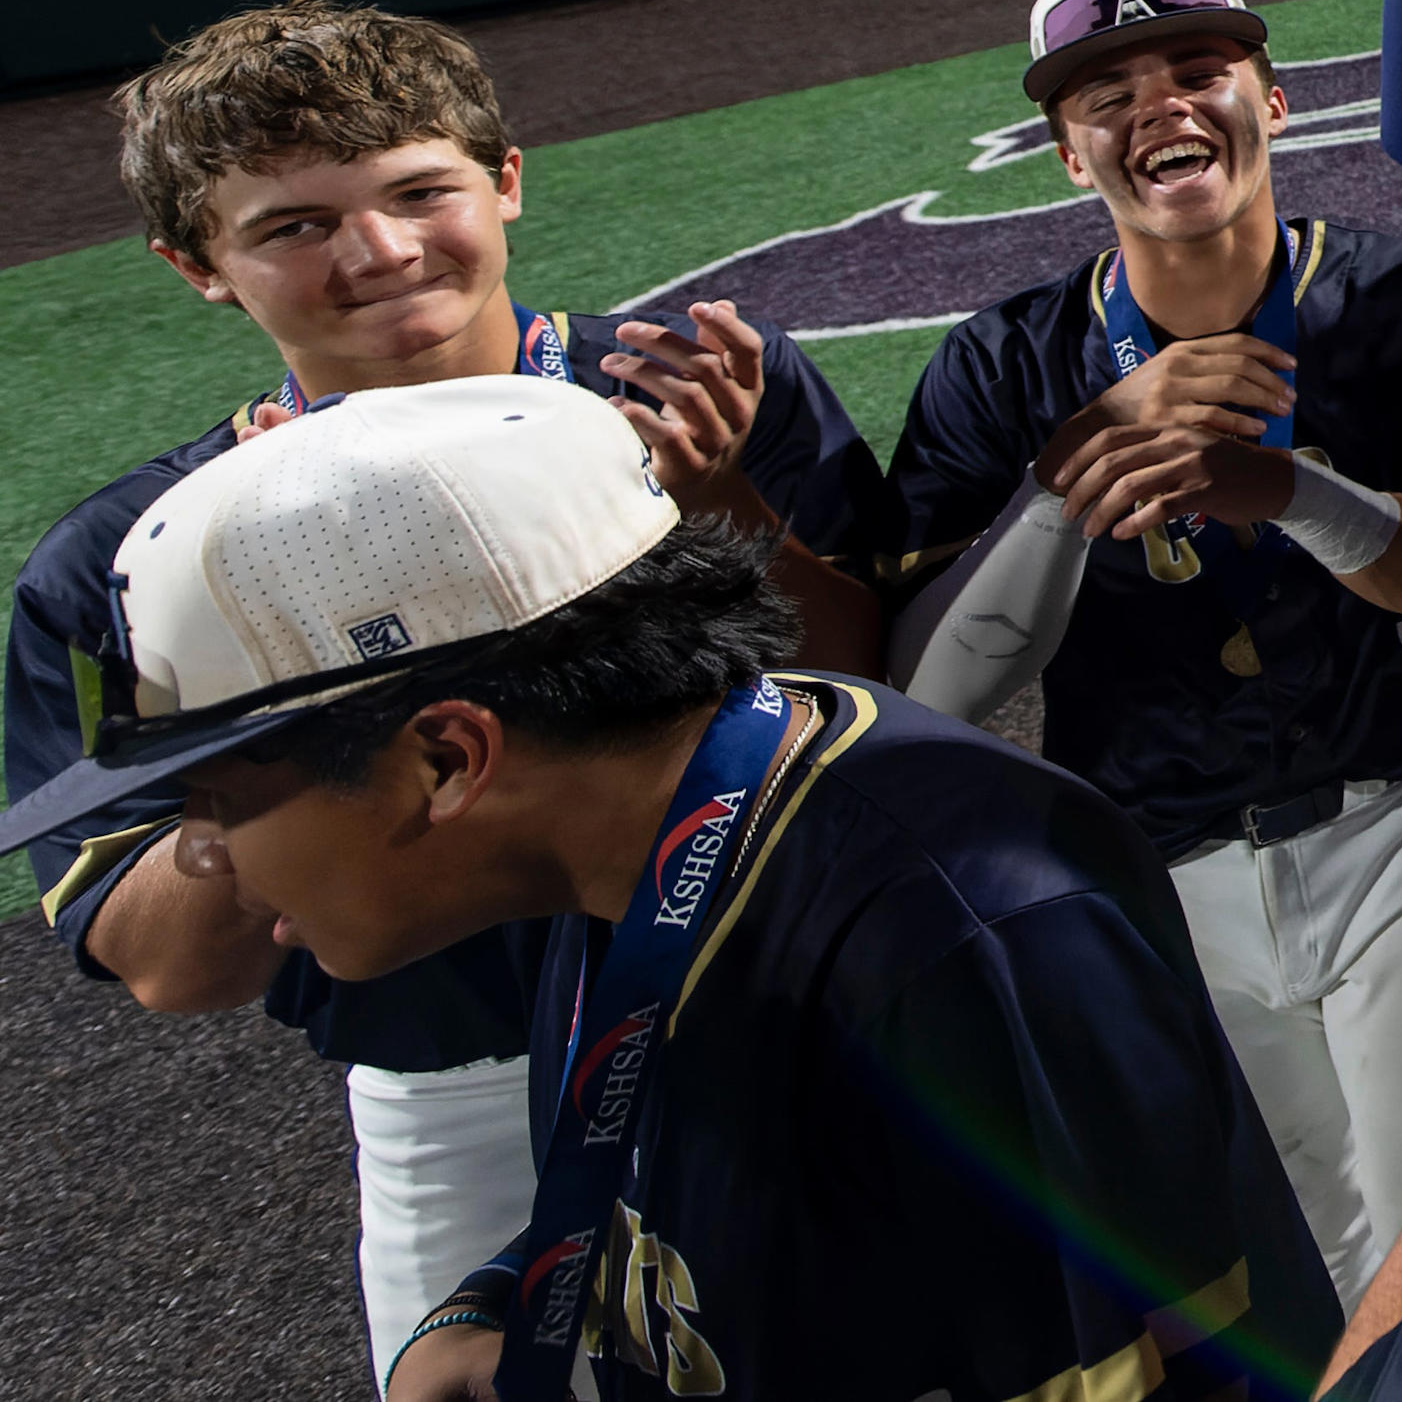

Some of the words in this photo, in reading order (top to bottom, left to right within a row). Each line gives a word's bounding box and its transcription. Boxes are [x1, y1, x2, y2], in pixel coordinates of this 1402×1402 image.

[654, 788, 747, 929] KSHSAA
[584, 1002, 660, 1147] KSHSAA
[534, 1227, 596, 1347] KSHSAA
